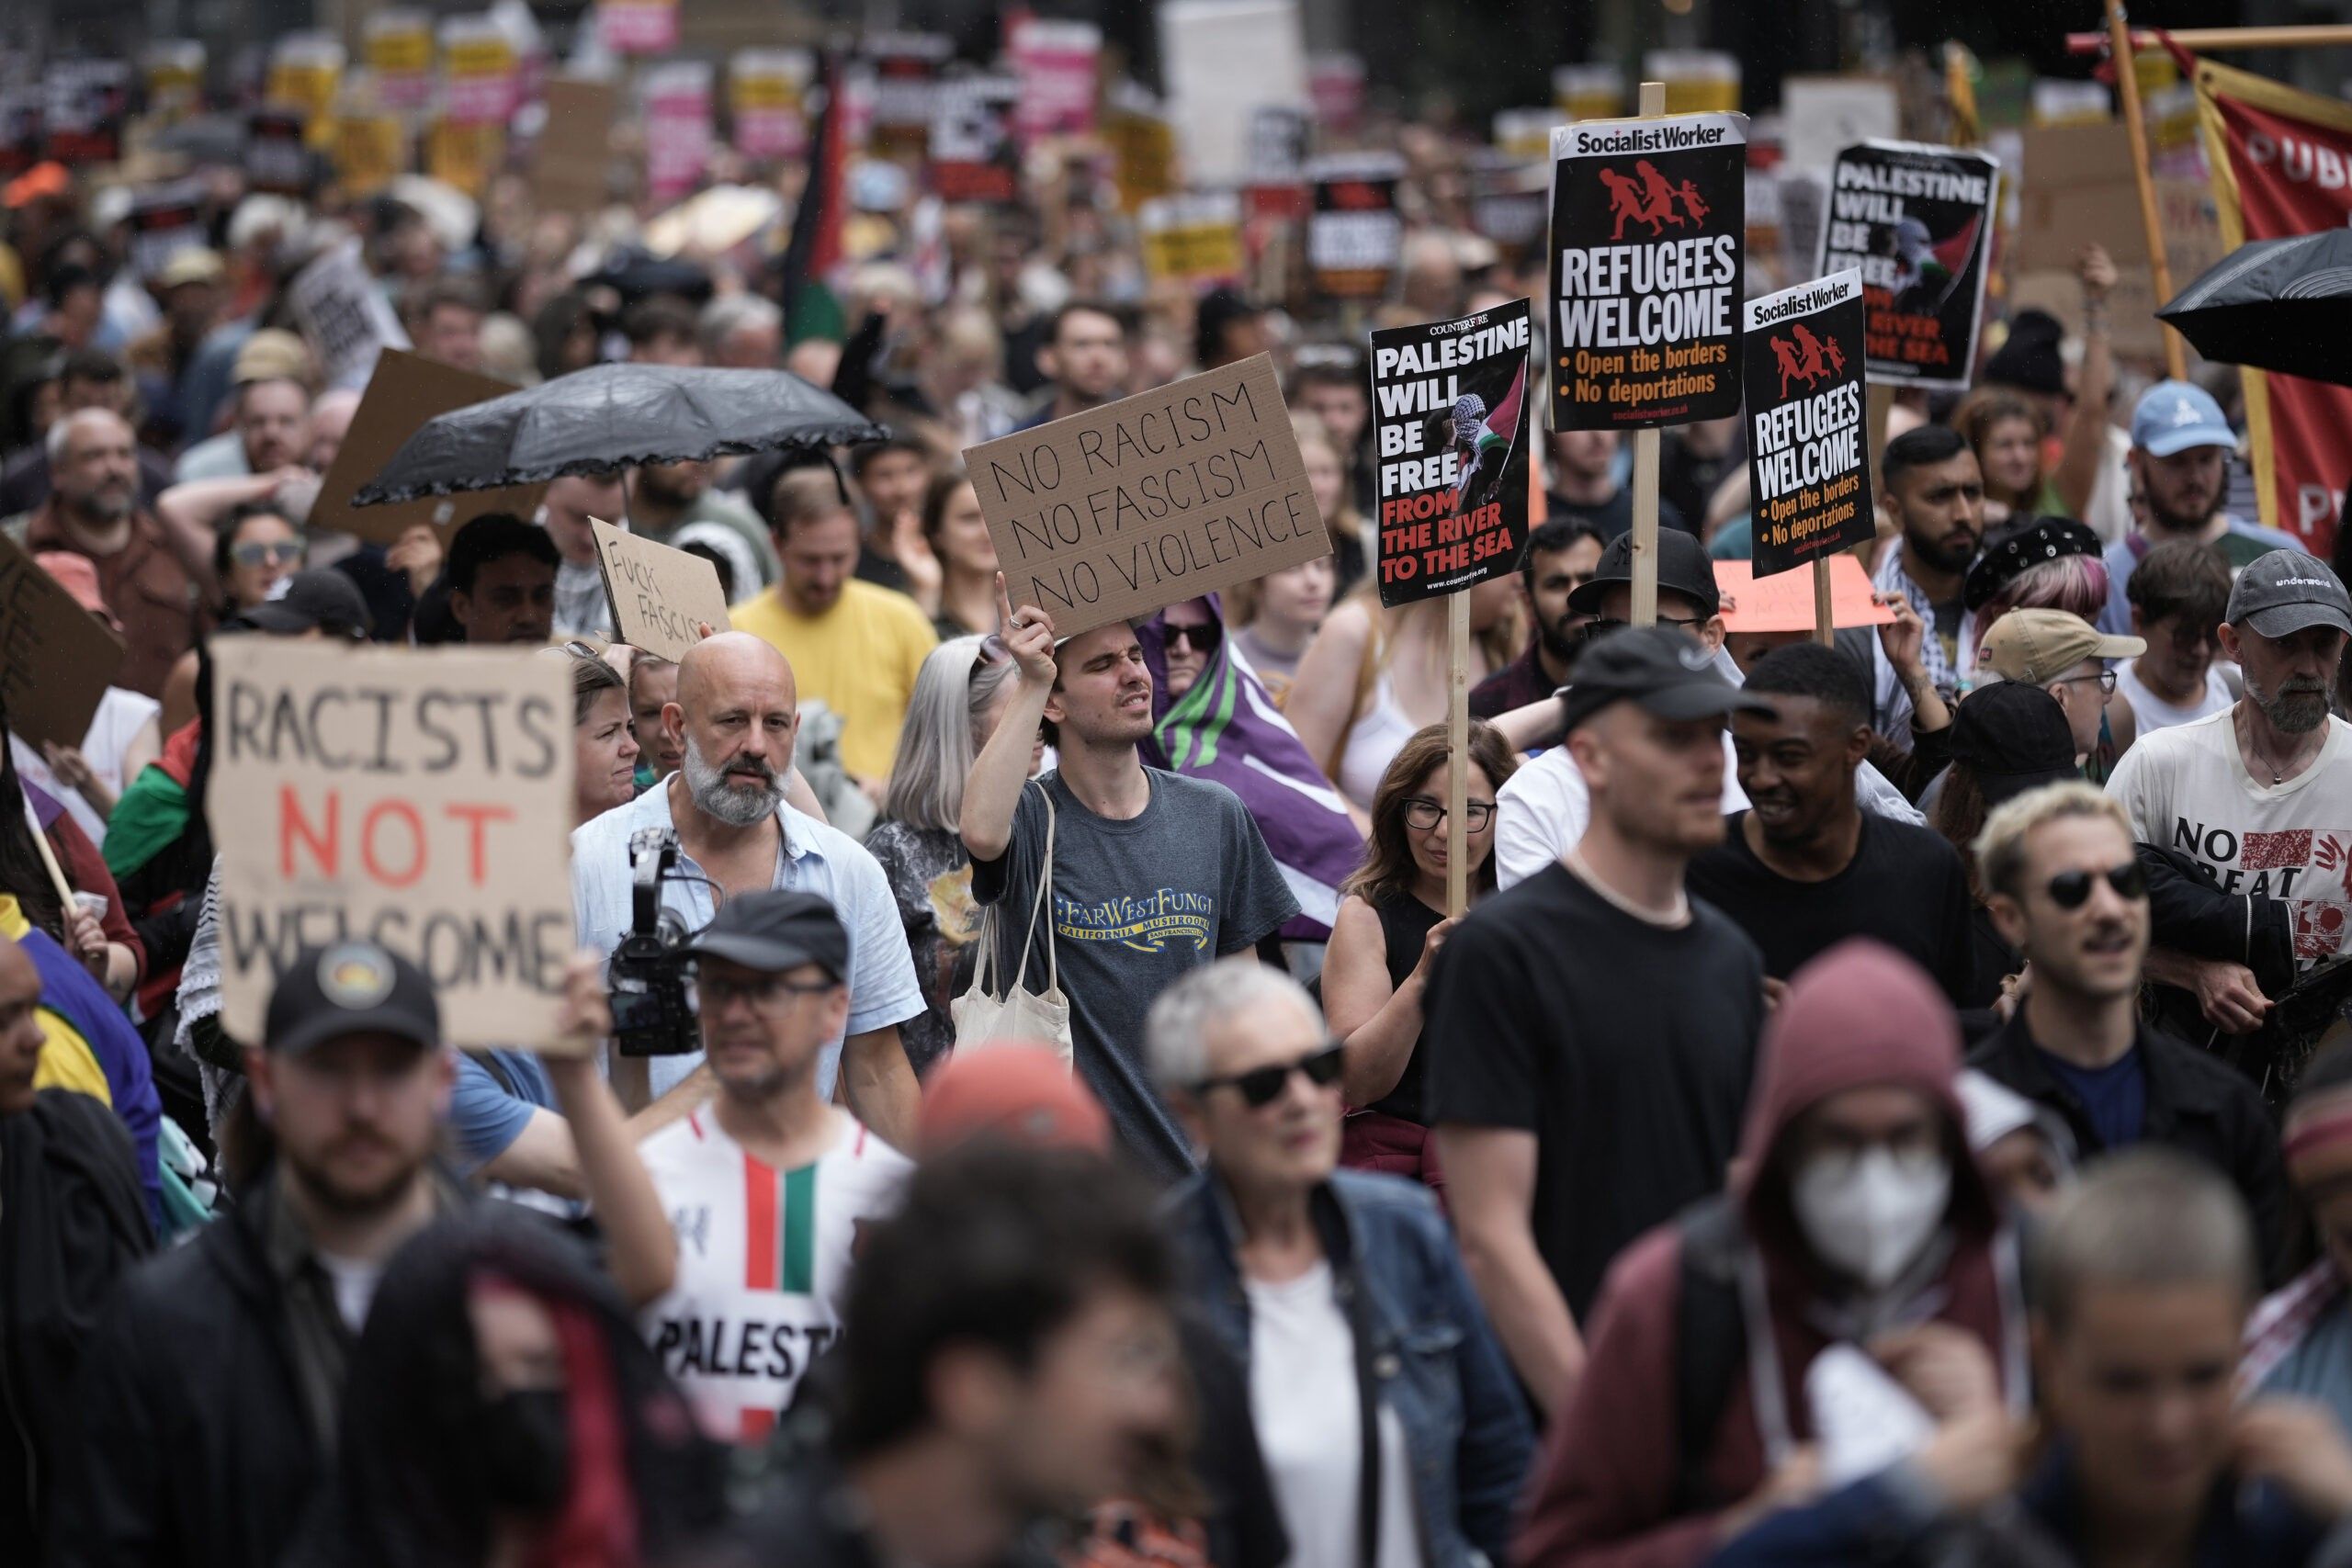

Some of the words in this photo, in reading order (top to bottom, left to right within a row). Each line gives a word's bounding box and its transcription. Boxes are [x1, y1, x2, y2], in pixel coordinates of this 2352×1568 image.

[1577, 129, 1662, 154] Socialist
[1663, 123, 1725, 148] Worker
[1838, 160, 1987, 206] PALESTINE
[1837, 191, 1905, 225] WILL
[1830, 220, 1871, 253] BE
[1562, 234, 1736, 297] REFUGEES
[1559, 287, 1733, 348] WELCOME
[1754, 293, 1812, 325] Socialist
[1812, 281, 1849, 310] Worker
[1376, 316, 1529, 379] PALESTINE
[1575, 350, 1624, 380] Open
[1631, 347, 1660, 373] the
[1665, 341, 1727, 369] borders
[1865, 333, 1899, 358] HE
[1377, 375, 1464, 418] WILL
[1575, 378, 1602, 403] No
[1609, 371, 1716, 407] deportations
[1380, 420, 1424, 458] BE
[1755, 379, 1860, 457] REFUGEES
[989, 445, 1061, 503] NO
[1078, 382, 1259, 476] RACISM
[1757, 424, 1861, 502] WELCOME
[1382, 451, 1459, 497] FREE
[1011, 503, 1081, 559] NO
[1087, 439, 1276, 536] FASCISM
[1382, 488, 1460, 527] FROM
[1770, 499, 1798, 525] Open
[1799, 489, 1821, 511] the
[1824, 474, 1860, 503] borders
[1381, 523, 1432, 556] THE
[1438, 502, 1501, 545] RIVER
[1772, 524, 1789, 547] No
[1791, 502, 1856, 541] deportations
[608, 540, 662, 598] FUCK
[1032, 560, 1101, 613] NO
[1106, 491, 1313, 592] VIOLENCE
[1381, 555, 1419, 584] TO
[1423, 542, 1470, 575] THE
[1473, 527, 1514, 563] SEA
[2276, 576, 2332, 588] underworld
[638, 593, 717, 645] FASCIS
[227, 681, 558, 780] RACISTS
[277, 781, 518, 891] NOT
[2173, 816, 2238, 863] NO
[1060, 925, 1135, 939] CALIFORNIA
[1142, 916, 1210, 931] MUSHROOMS
[1149, 931, 1163, 939] SAN
